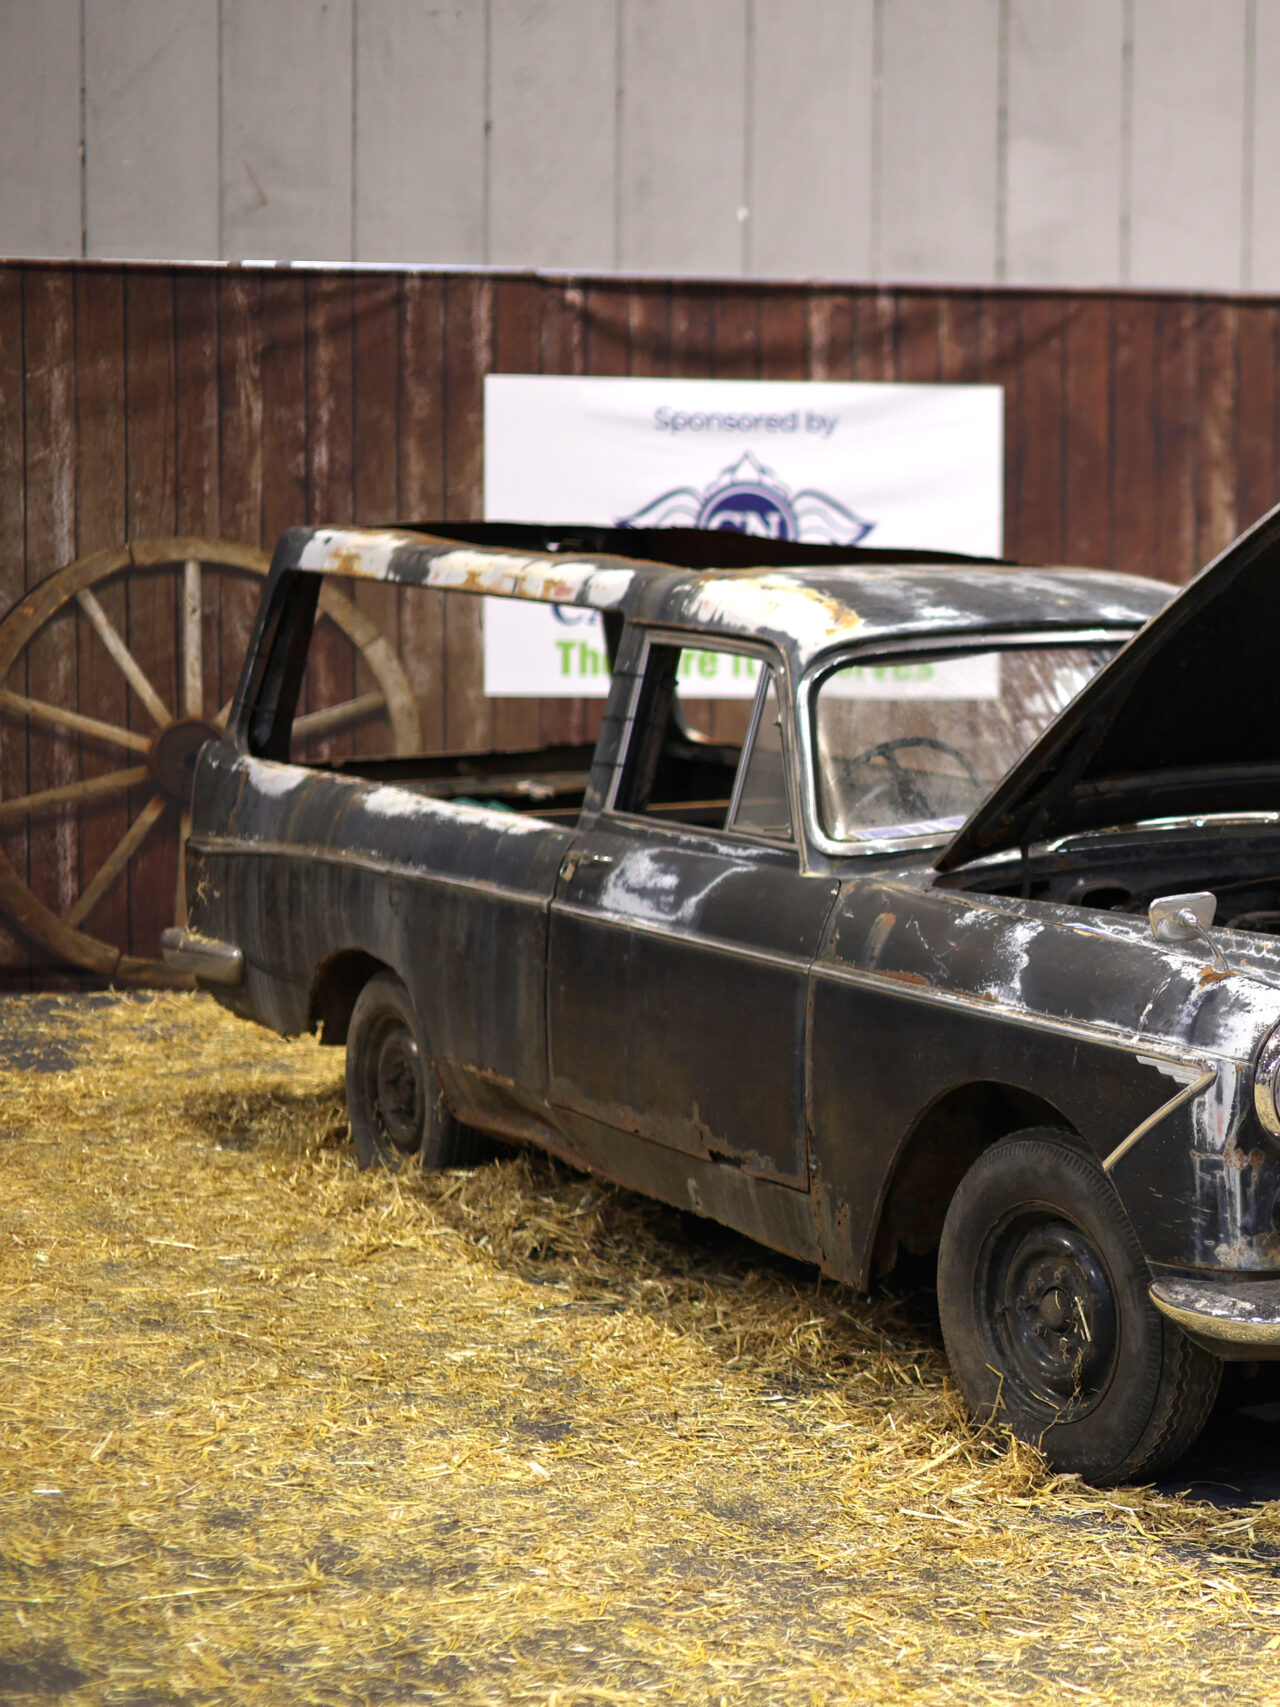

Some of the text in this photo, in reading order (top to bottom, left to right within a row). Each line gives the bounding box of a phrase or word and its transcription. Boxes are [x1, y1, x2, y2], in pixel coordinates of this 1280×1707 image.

[654, 406, 838, 438] Sponsored by
[555, 640, 608, 677] Th
